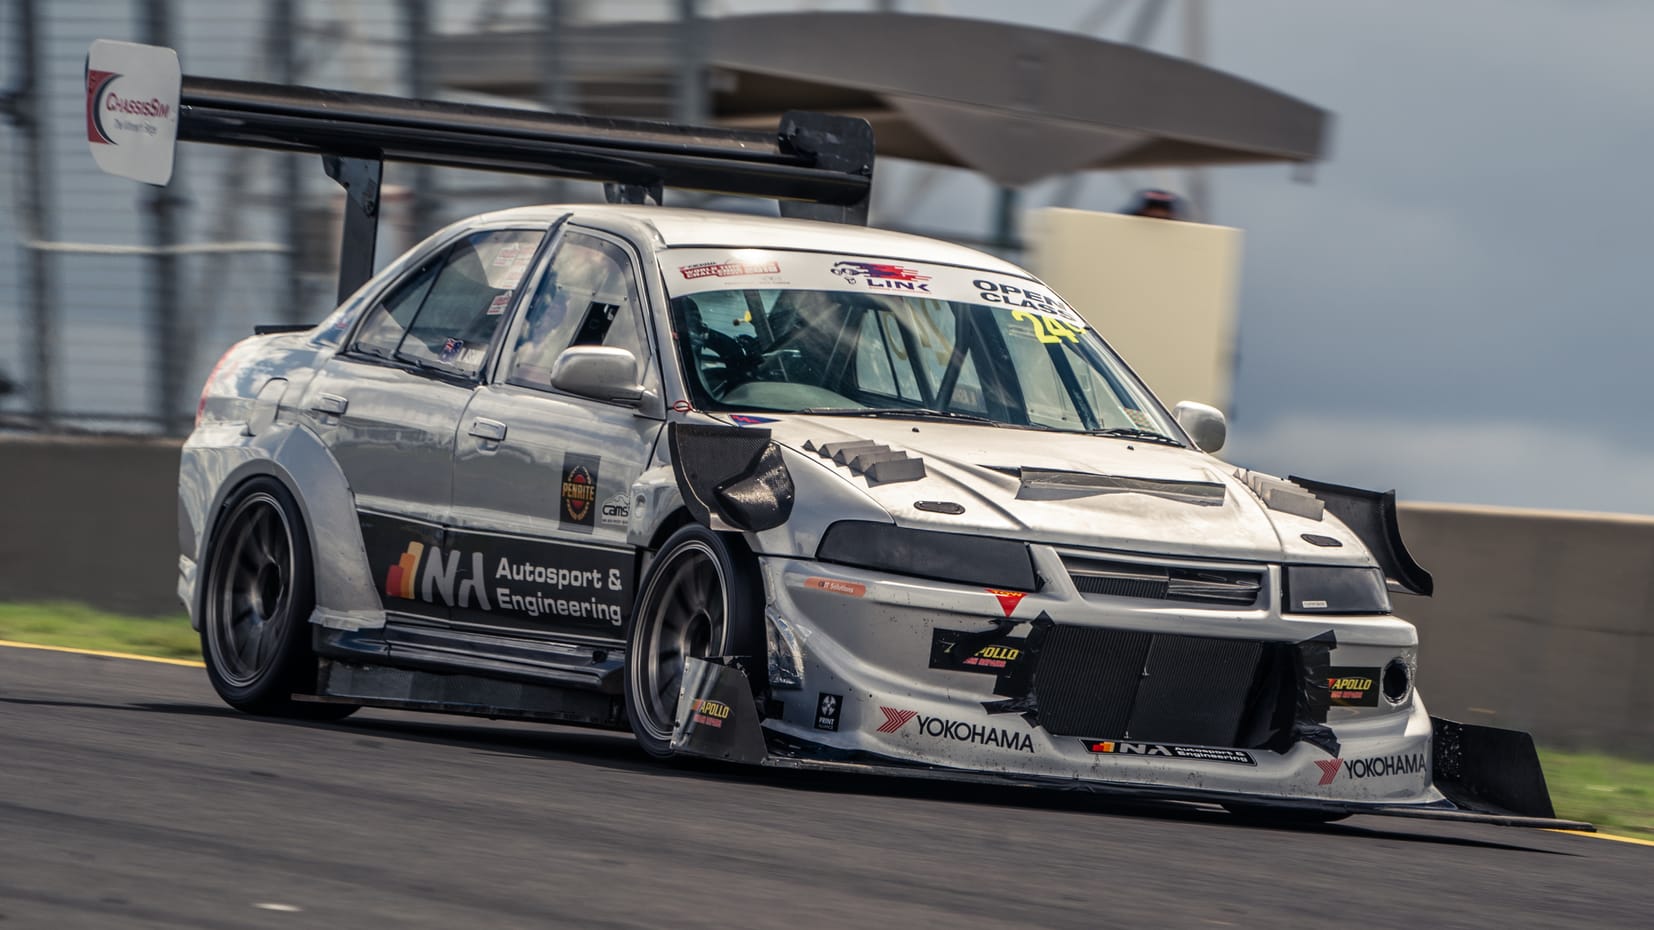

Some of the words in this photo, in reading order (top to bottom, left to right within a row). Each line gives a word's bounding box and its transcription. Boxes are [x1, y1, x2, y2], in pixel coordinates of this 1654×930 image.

[867, 279, 930, 292] LINK
[973, 279, 1066, 311] OPEN
[980, 292, 1077, 322] CLASS
[562, 482, 595, 500] PENRITE
[496, 557, 602, 590] Autosport
[608, 569, 622, 591] &
[497, 587, 622, 627] Engineering
[1331, 679, 1372, 690] APOLLO
[700, 701, 730, 718] APOLLO
[916, 715, 1035, 753] YOKOHAMA
[1344, 755, 1427, 779] YOKOHAMA
